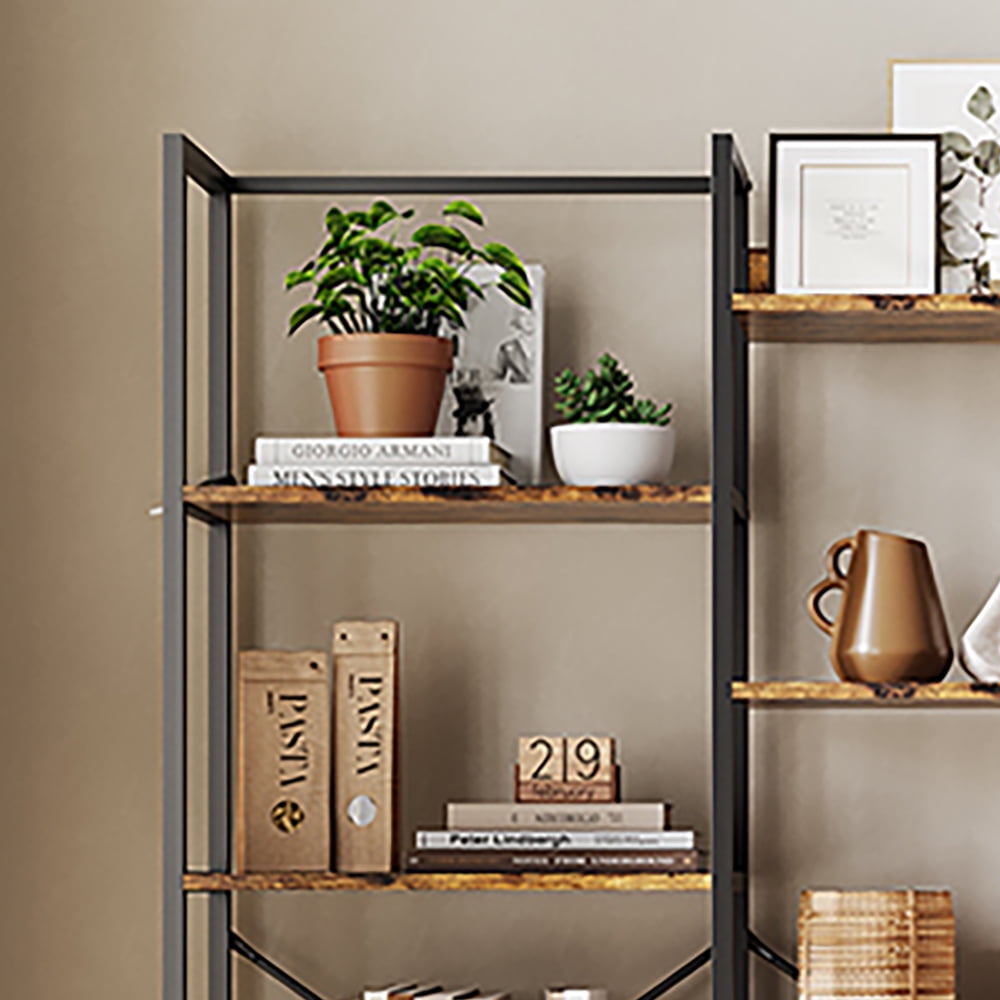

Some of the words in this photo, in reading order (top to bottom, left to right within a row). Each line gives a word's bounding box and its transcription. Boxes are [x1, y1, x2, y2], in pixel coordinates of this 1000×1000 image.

[291, 443, 373, 458] GIORGIO
[375, 443, 453, 458] ARMANI
[278, 694, 309, 787] PASTA
[356, 677, 383, 775] PASTA
